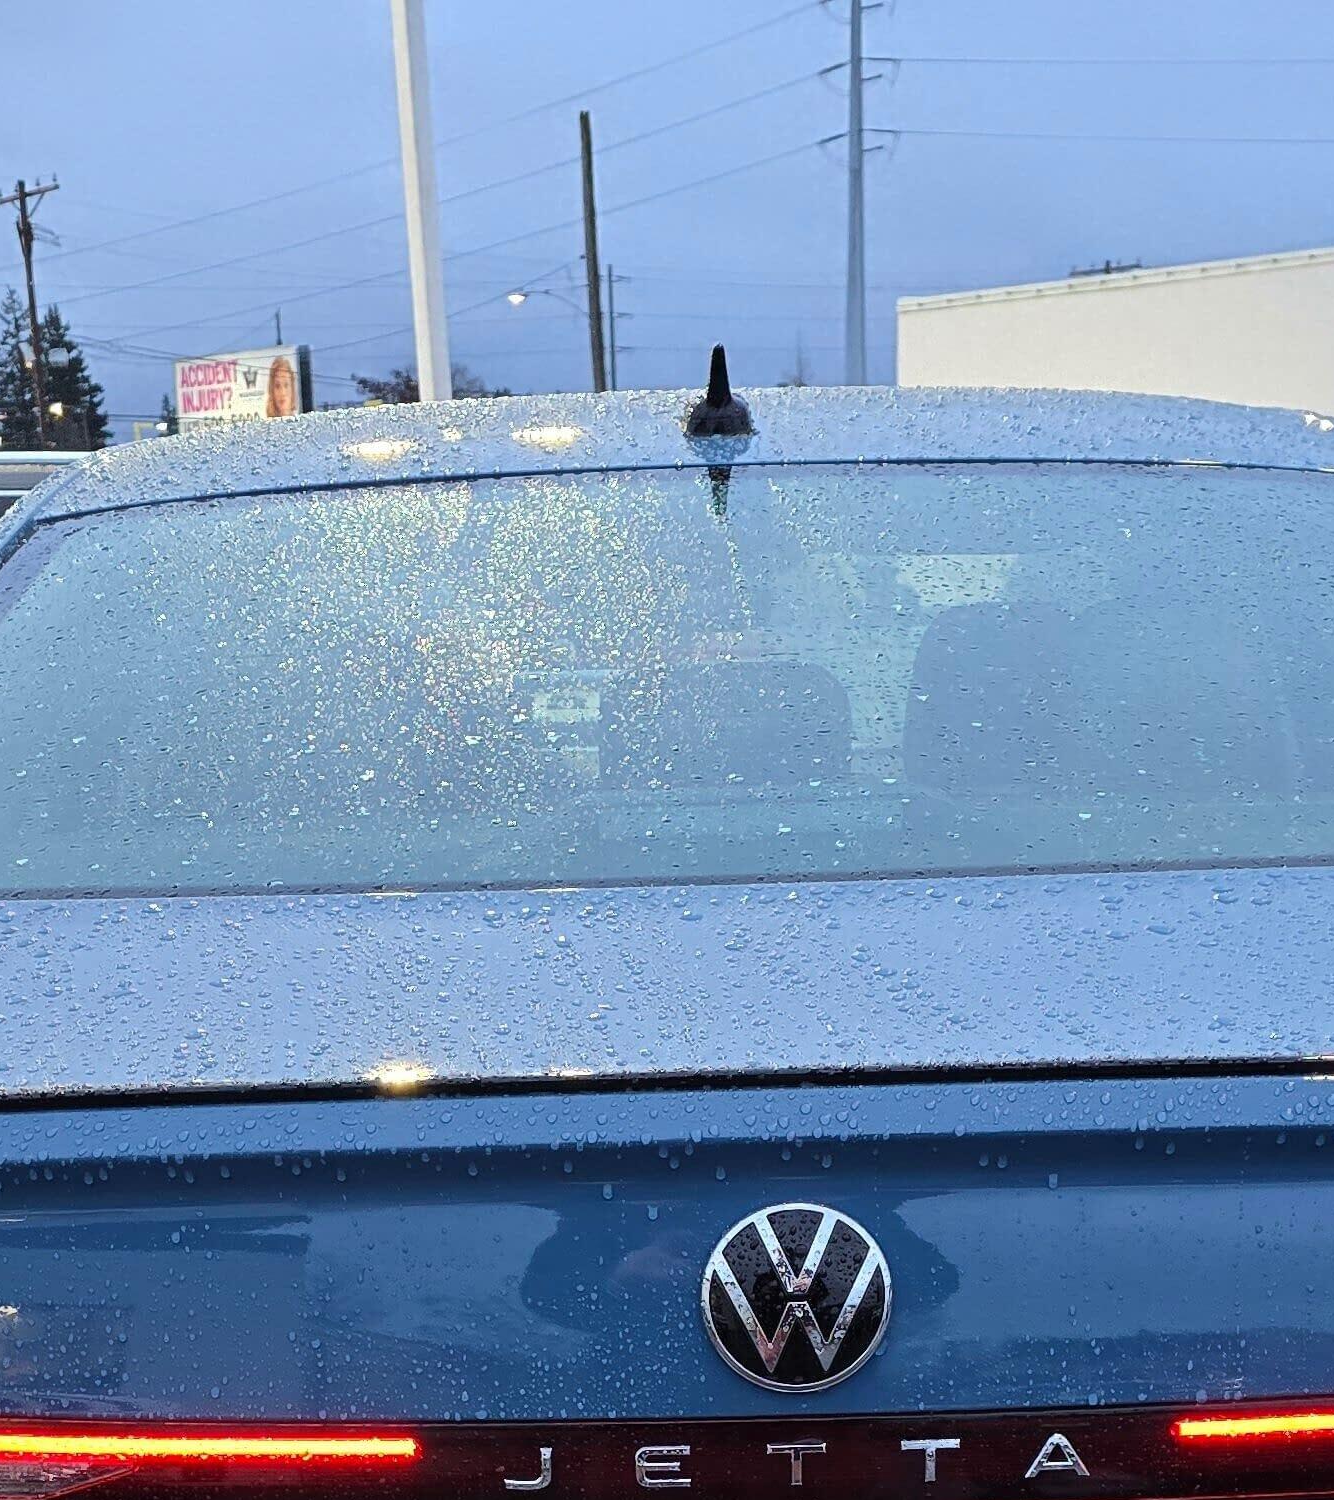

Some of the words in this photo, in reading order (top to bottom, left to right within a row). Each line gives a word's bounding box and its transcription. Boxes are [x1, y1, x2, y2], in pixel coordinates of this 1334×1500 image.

[181, 360, 238, 388] ACCIDENT
[182, 386, 233, 414] INJURY?
[503, 1432, 1091, 1490] JETTA
